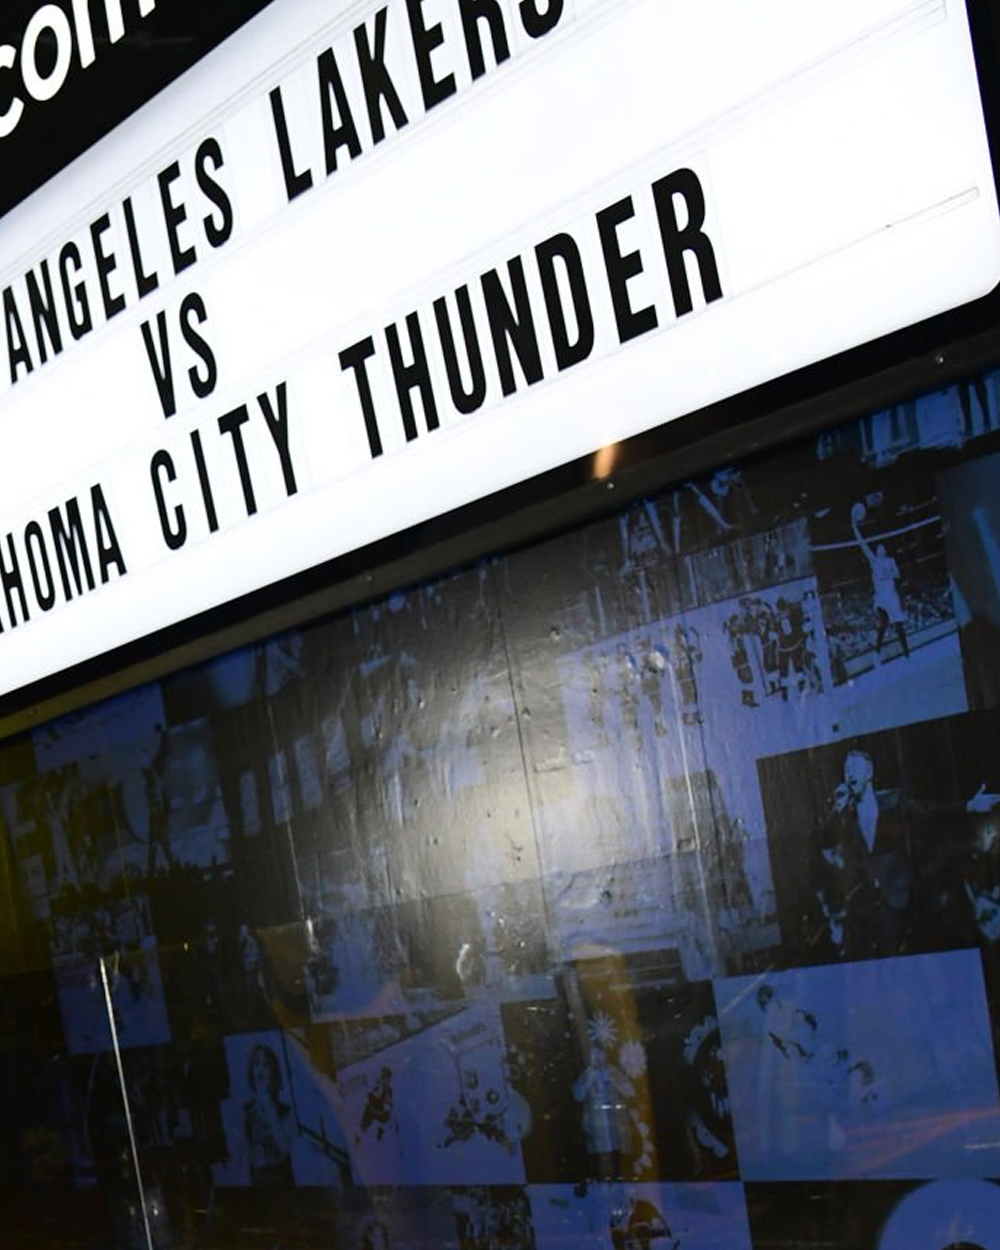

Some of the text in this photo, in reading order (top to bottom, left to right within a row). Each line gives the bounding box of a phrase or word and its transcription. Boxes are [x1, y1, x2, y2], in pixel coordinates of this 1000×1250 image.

[2, 137, 233, 384] ANGELES
[140, 292, 217, 419] VS
[150, 381, 298, 551] CITY
[338, 167, 724, 459] THUNDER
